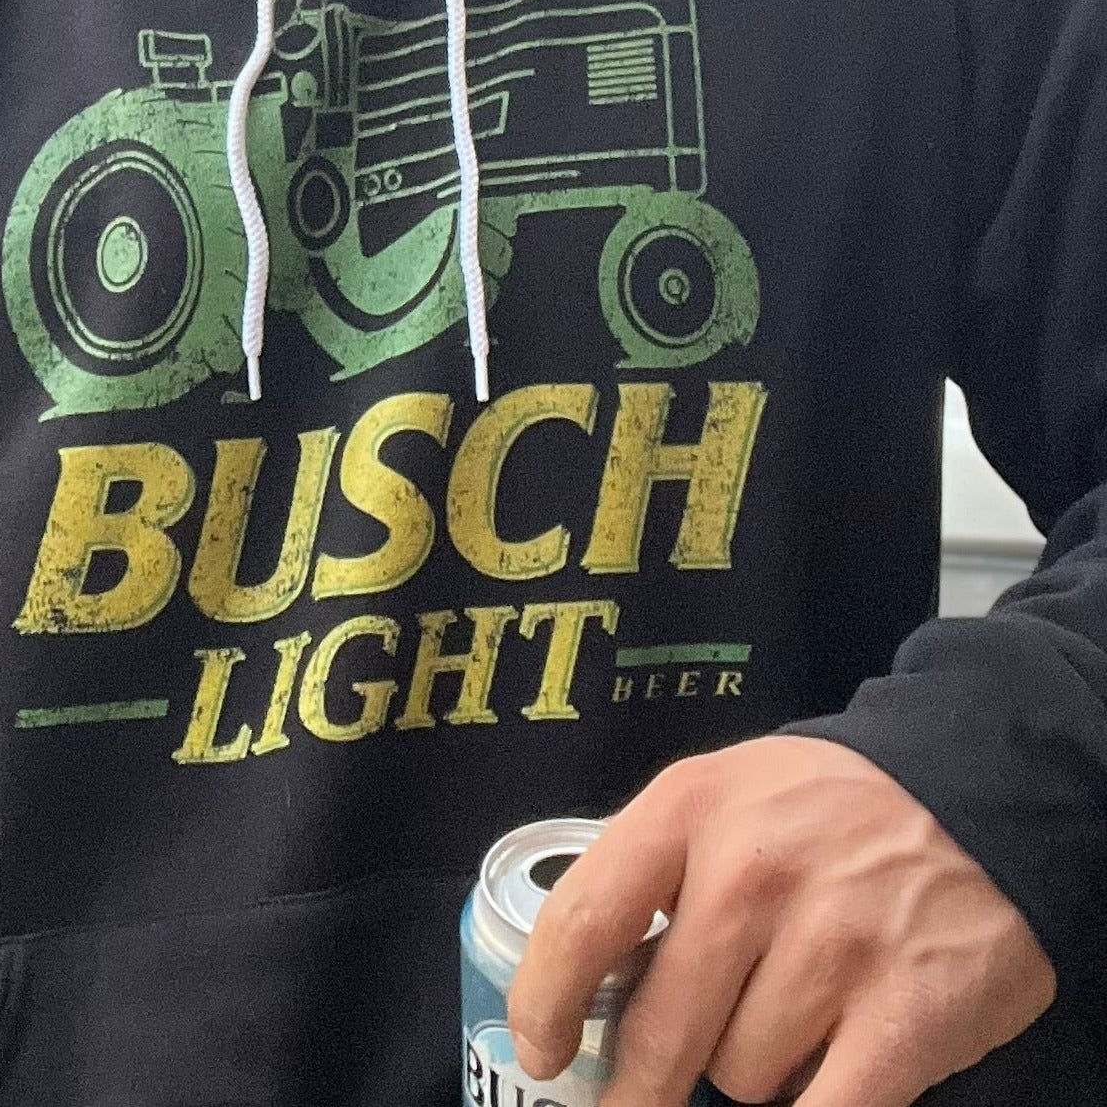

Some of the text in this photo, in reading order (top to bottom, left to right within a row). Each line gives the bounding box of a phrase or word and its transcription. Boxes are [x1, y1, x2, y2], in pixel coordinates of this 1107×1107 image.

[12, 380, 768, 635] BUSCH
[171, 598, 620, 765] LIGHT
[611, 671, 743, 703] BEER
